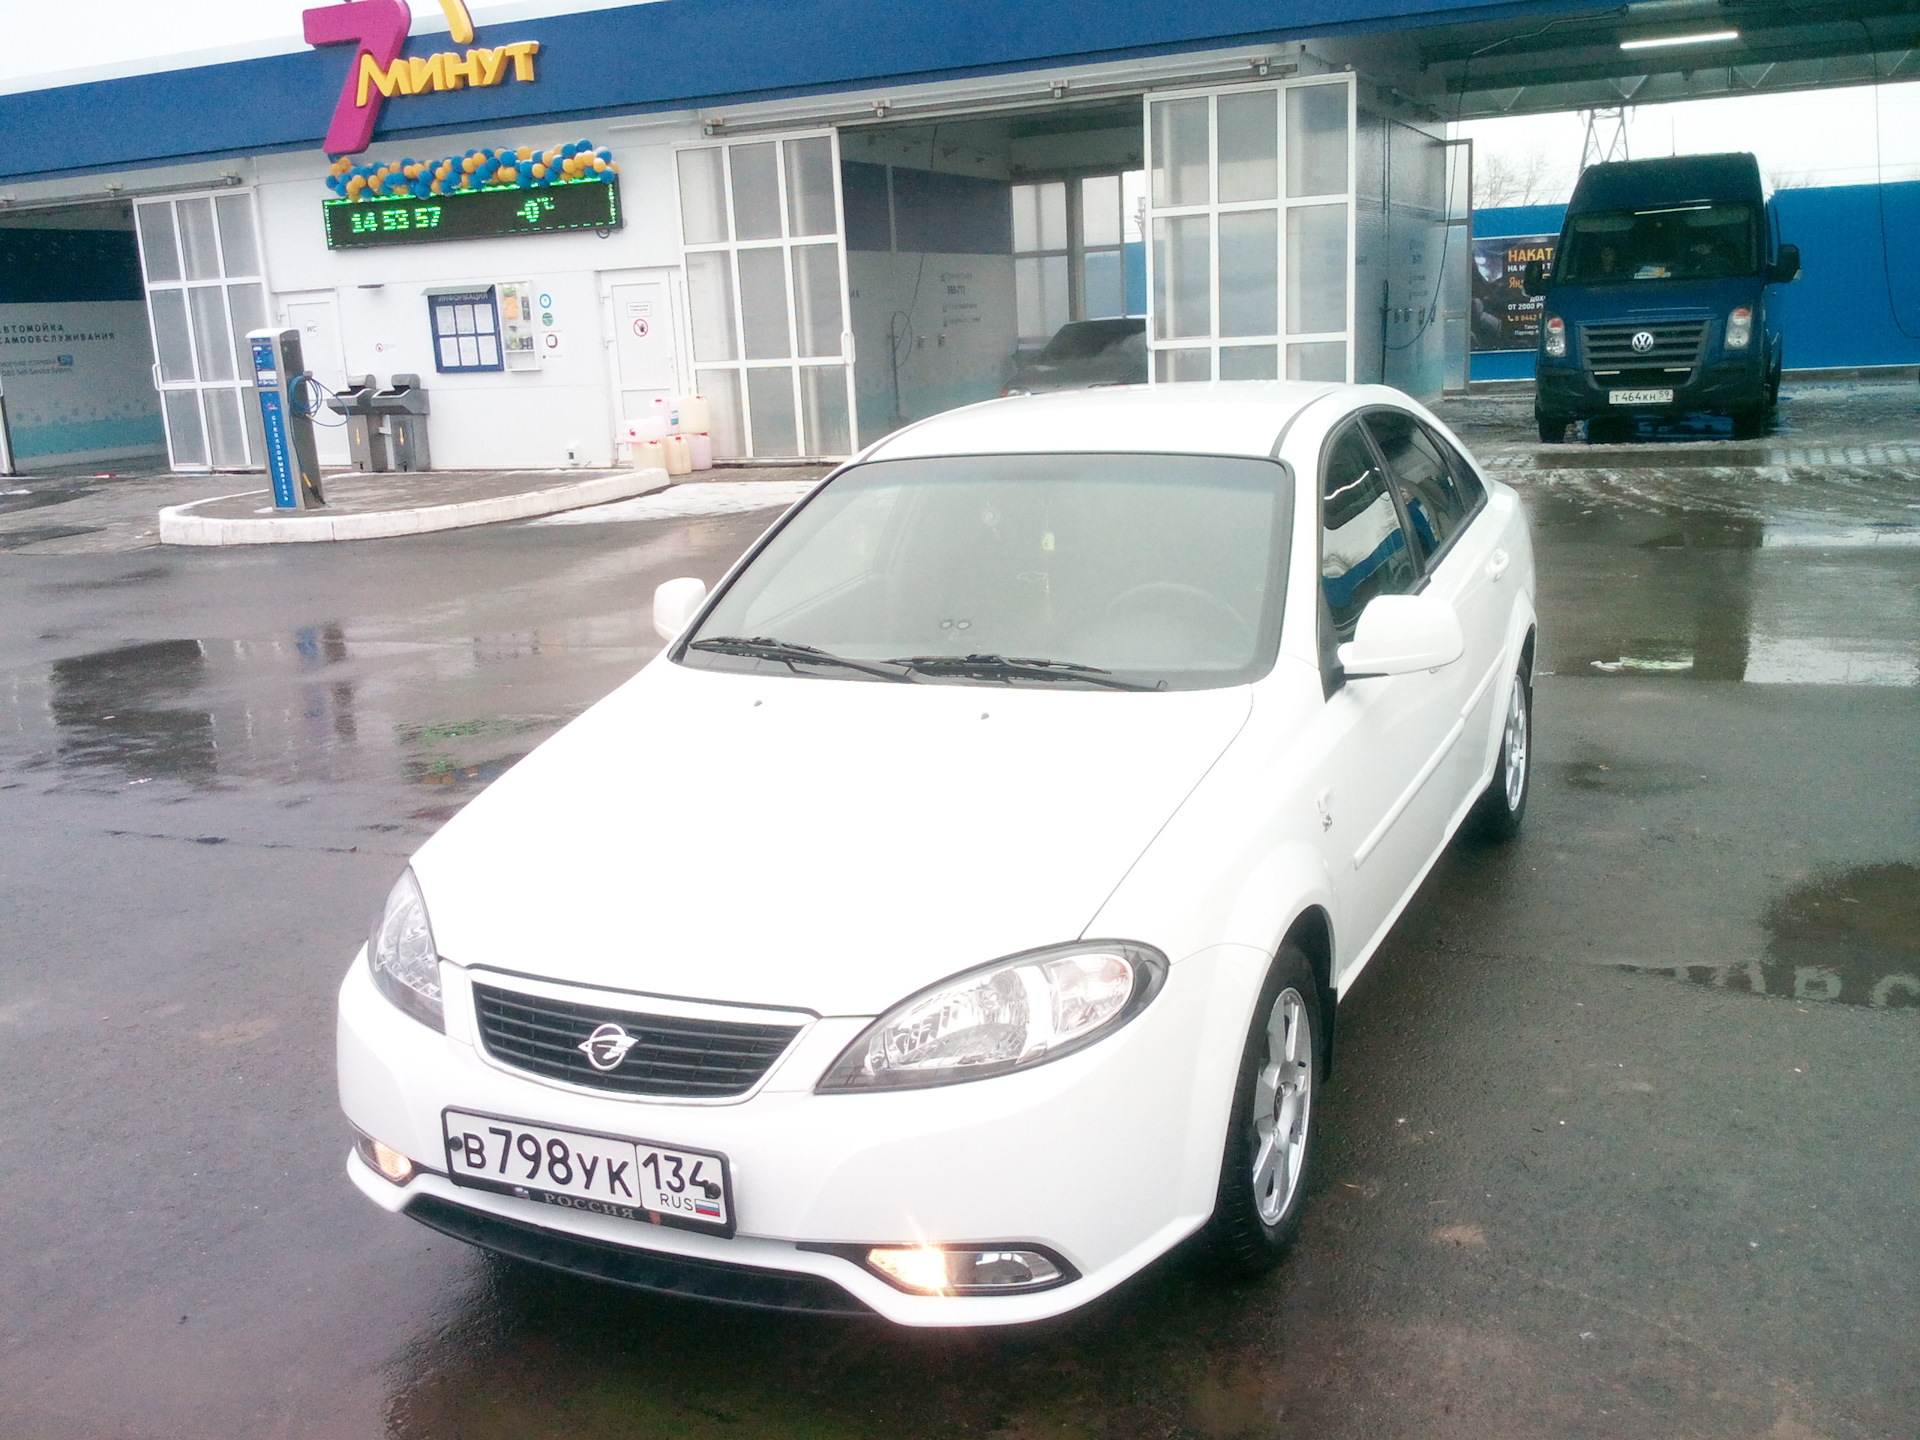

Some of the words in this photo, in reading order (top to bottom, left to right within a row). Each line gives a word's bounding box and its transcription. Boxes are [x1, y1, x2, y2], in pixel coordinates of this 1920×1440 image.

[303, 0, 412, 154] 7
[356, 41, 540, 107] МИНУТ
[351, 212, 379, 233] 14
[382, 209, 410, 230] 53
[414, 206, 442, 229] 57
[1508, 247, 1554, 262] НАКАТ
[0, 323, 64, 334] ВТОМОЙКА
[306, 325, 318, 333] WC
[1614, 392, 1656, 402] Т464КН
[1659, 390, 1670, 398] 59
[463, 1127, 633, 1198] В798УК
[641, 1152, 710, 1193] 134
[543, 1192, 636, 1220] РОССИЯ
[660, 1194, 694, 1211] RUS
